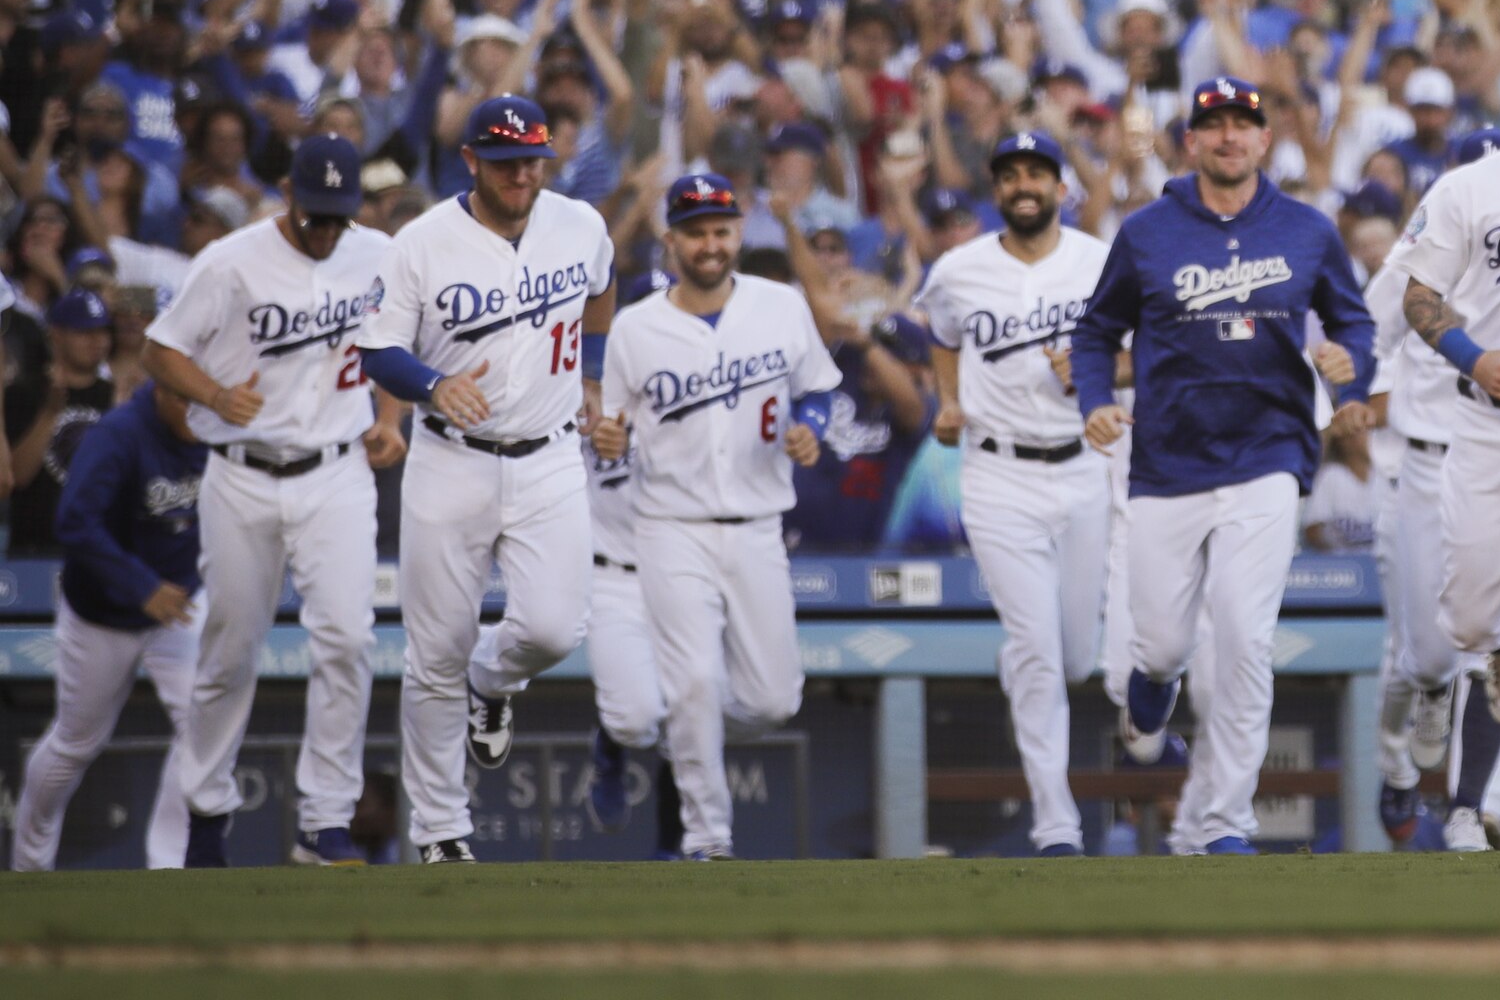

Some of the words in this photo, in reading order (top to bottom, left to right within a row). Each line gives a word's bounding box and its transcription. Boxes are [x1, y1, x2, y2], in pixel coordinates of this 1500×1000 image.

[435, 262, 590, 333] Dodgers
[1173, 253, 1293, 312] Dodgers
[550, 319, 583, 377] 13
[644, 349, 788, 412] Dodgers
